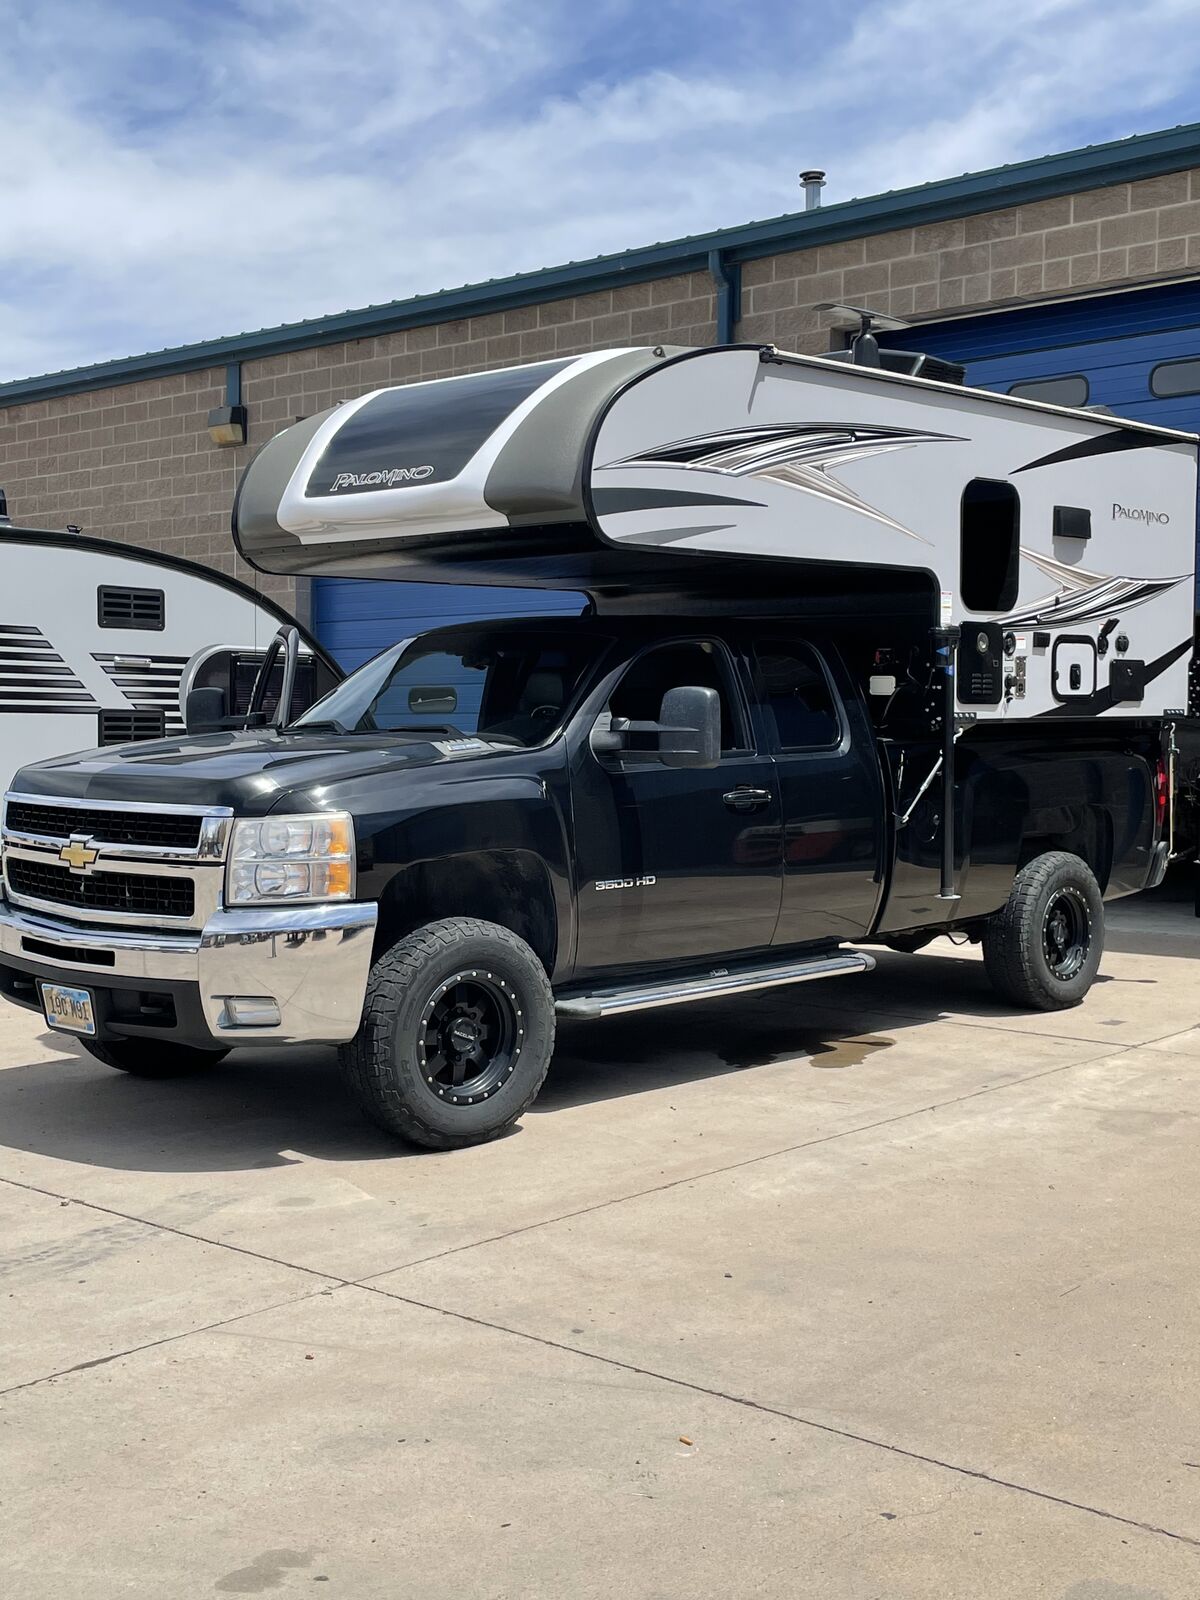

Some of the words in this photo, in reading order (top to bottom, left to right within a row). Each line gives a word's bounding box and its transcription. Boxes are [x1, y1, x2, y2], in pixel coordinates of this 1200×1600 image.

[329, 465, 434, 491] PALOMINO
[1112, 503, 1170, 526] PALOMINO
[635, 875, 656, 886] HD
